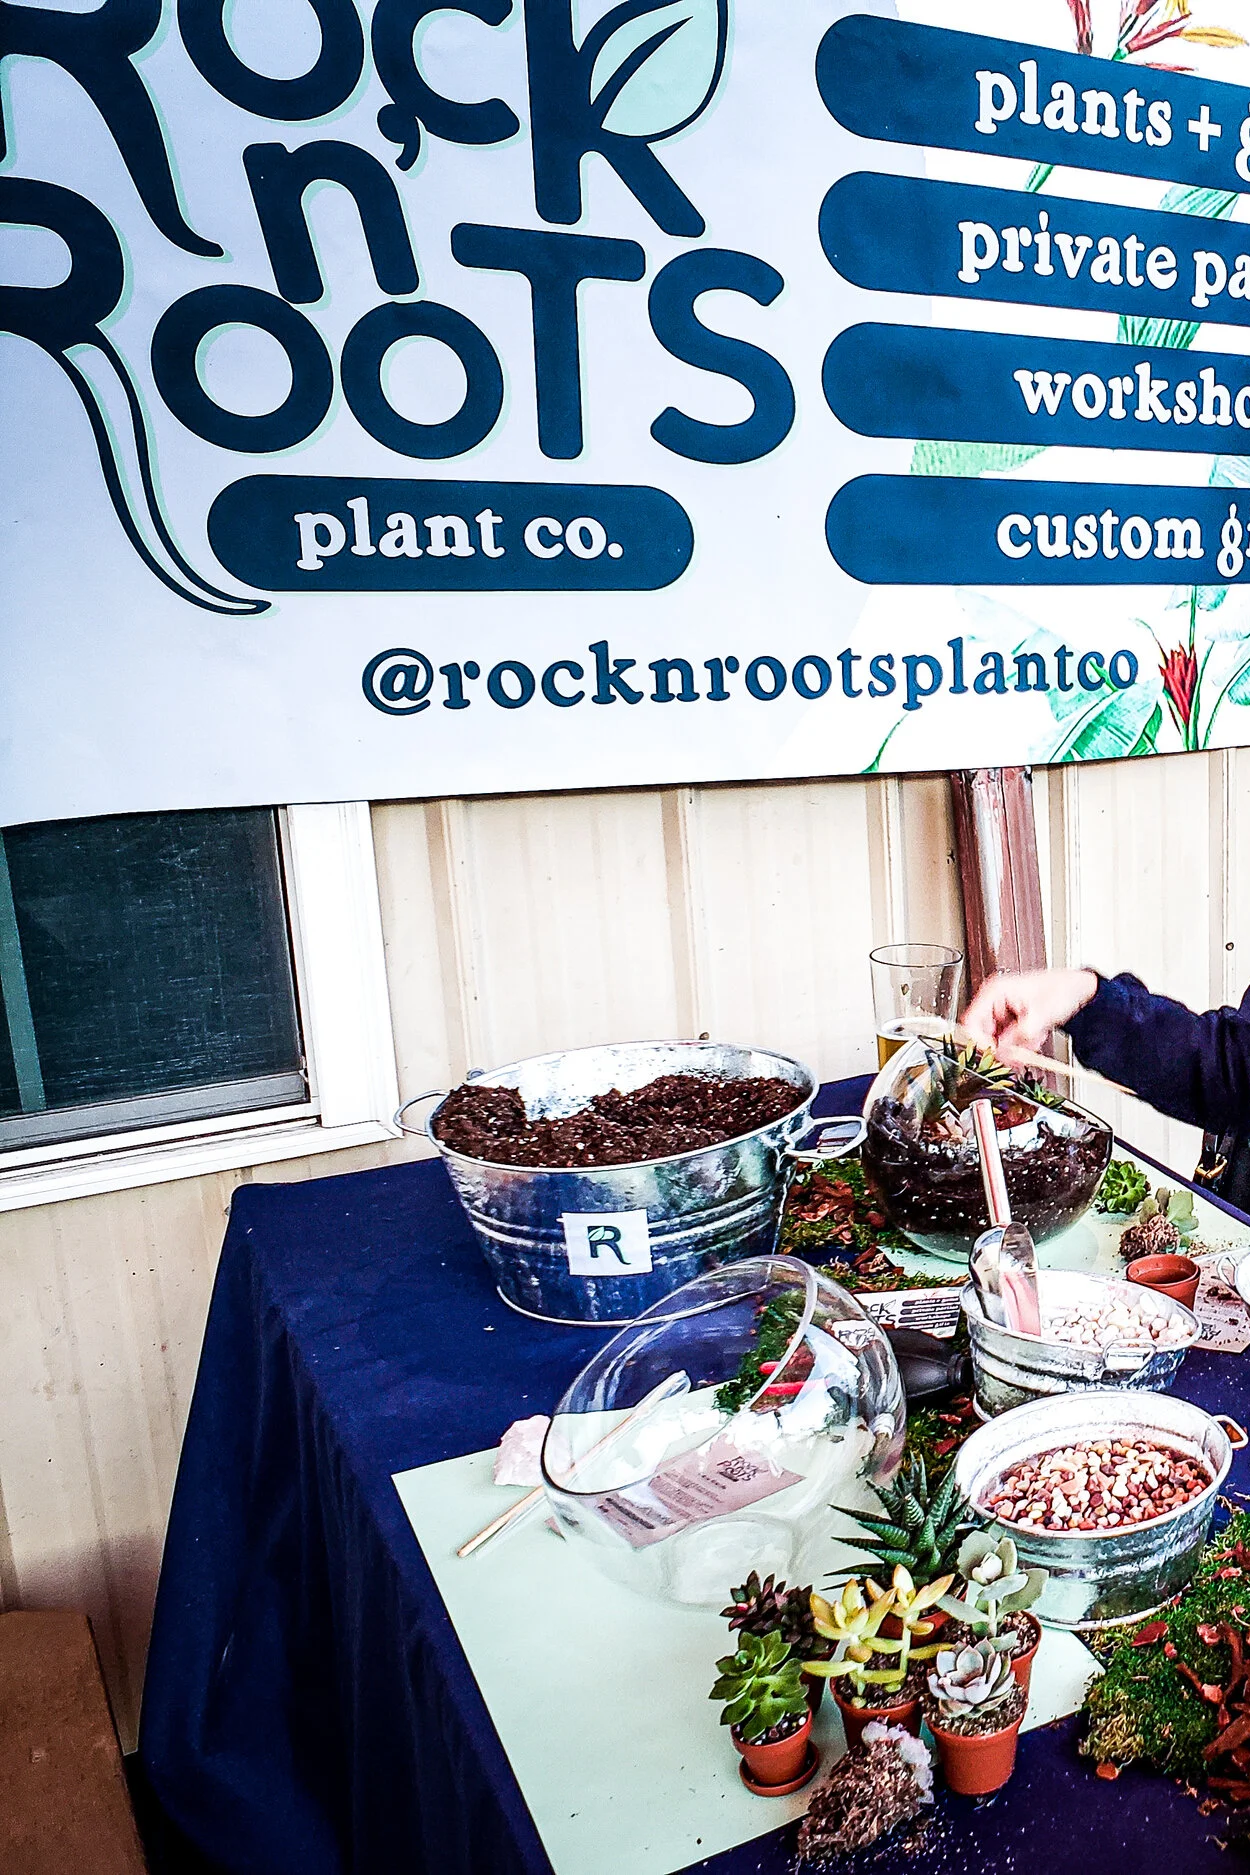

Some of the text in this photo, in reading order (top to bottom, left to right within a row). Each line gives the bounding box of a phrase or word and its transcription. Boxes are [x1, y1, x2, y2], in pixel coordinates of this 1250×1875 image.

[974, 60, 1173, 148] plants
[1187, 105, 1222, 152] +
[958, 211, 1178, 290] private
[295, 497, 624, 571] plant co.
[997, 508, 1204, 560] custom
[362, 636, 1140, 717] @rocknrootsplantco
[587, 1226, 632, 1265] R
